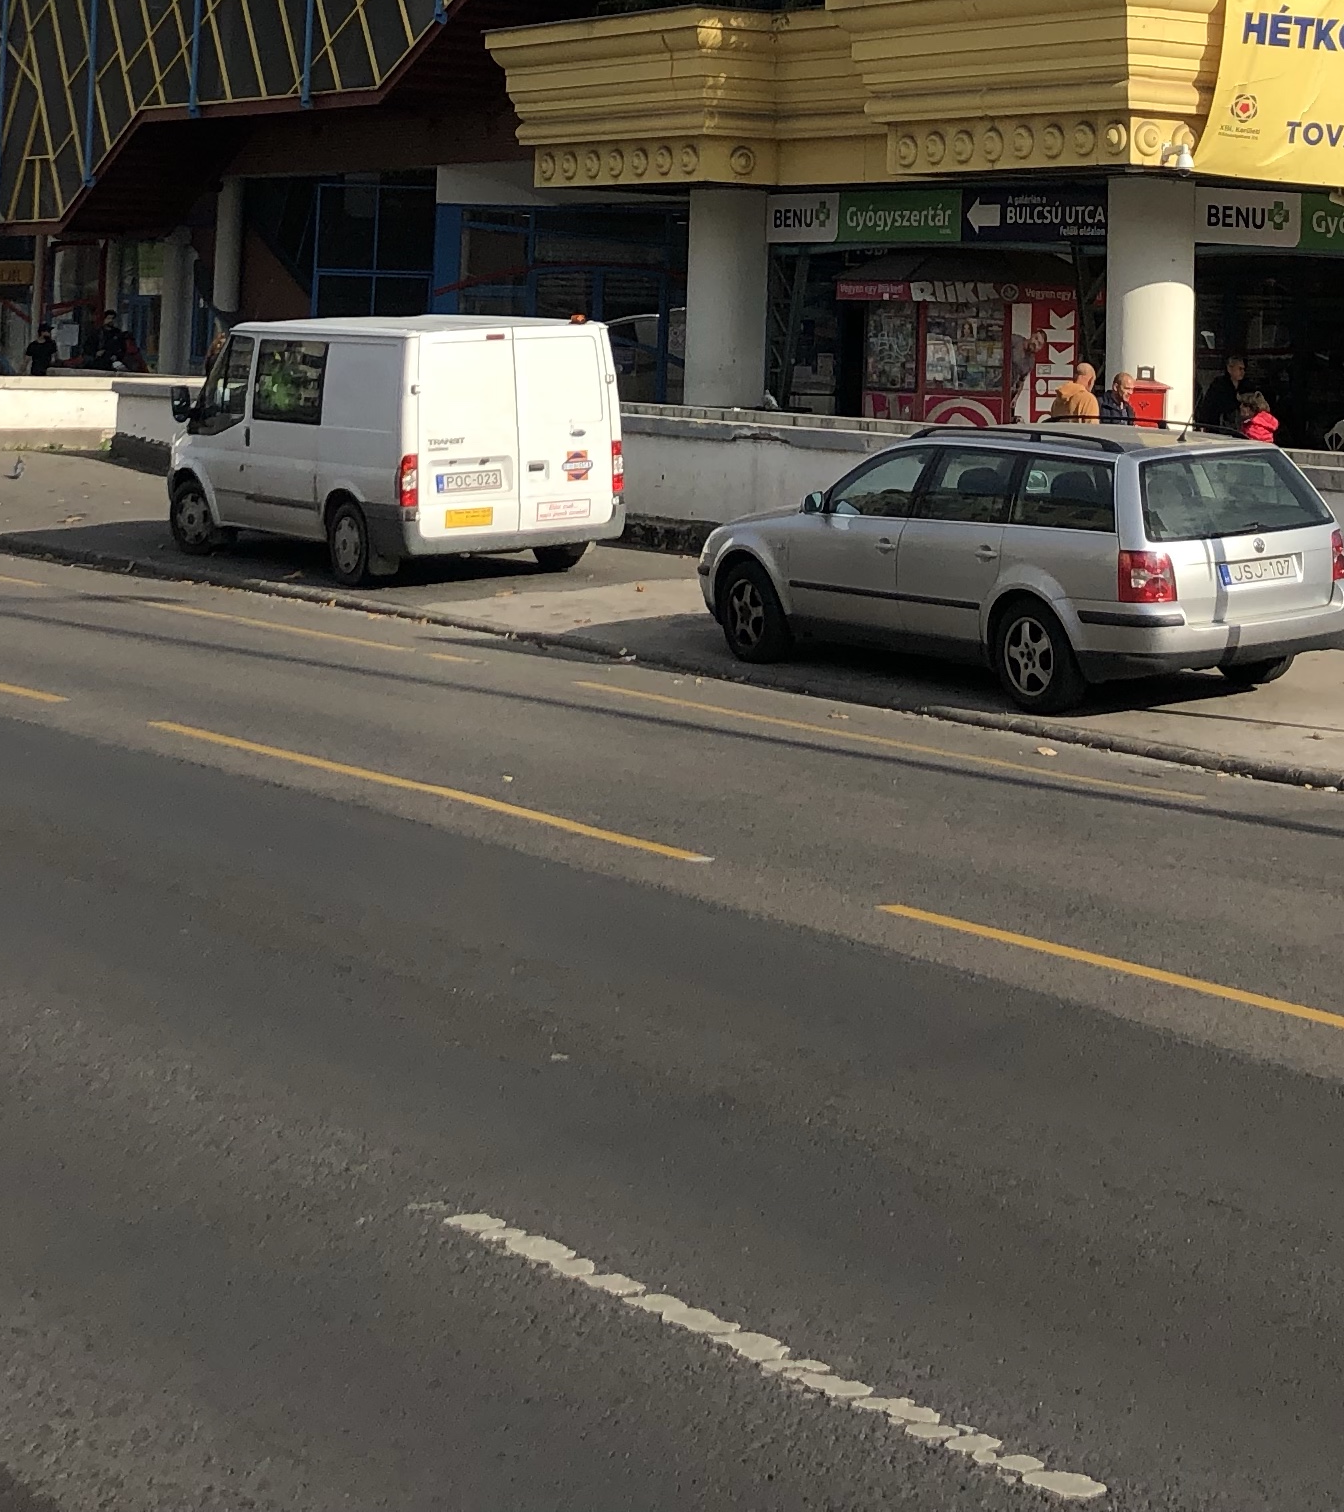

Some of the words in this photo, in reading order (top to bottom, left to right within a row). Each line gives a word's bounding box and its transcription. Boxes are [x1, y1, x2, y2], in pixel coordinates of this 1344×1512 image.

[773, 208, 814, 228] BENU
[846, 205, 952, 233] Gyógyszertár
[1006, 201, 1062, 224] BULCSÚ
[1065, 205, 1106, 224] UTCA
[1206, 204, 1266, 230] BENU
[1024, 288, 1057, 301] Vegyen
[1057, 289, 1071, 301] egy
[428, 436, 465, 446] TRANSIT
[445, 472, 500, 489] POC-023
[1233, 559, 1292, 582] JSJ-107
